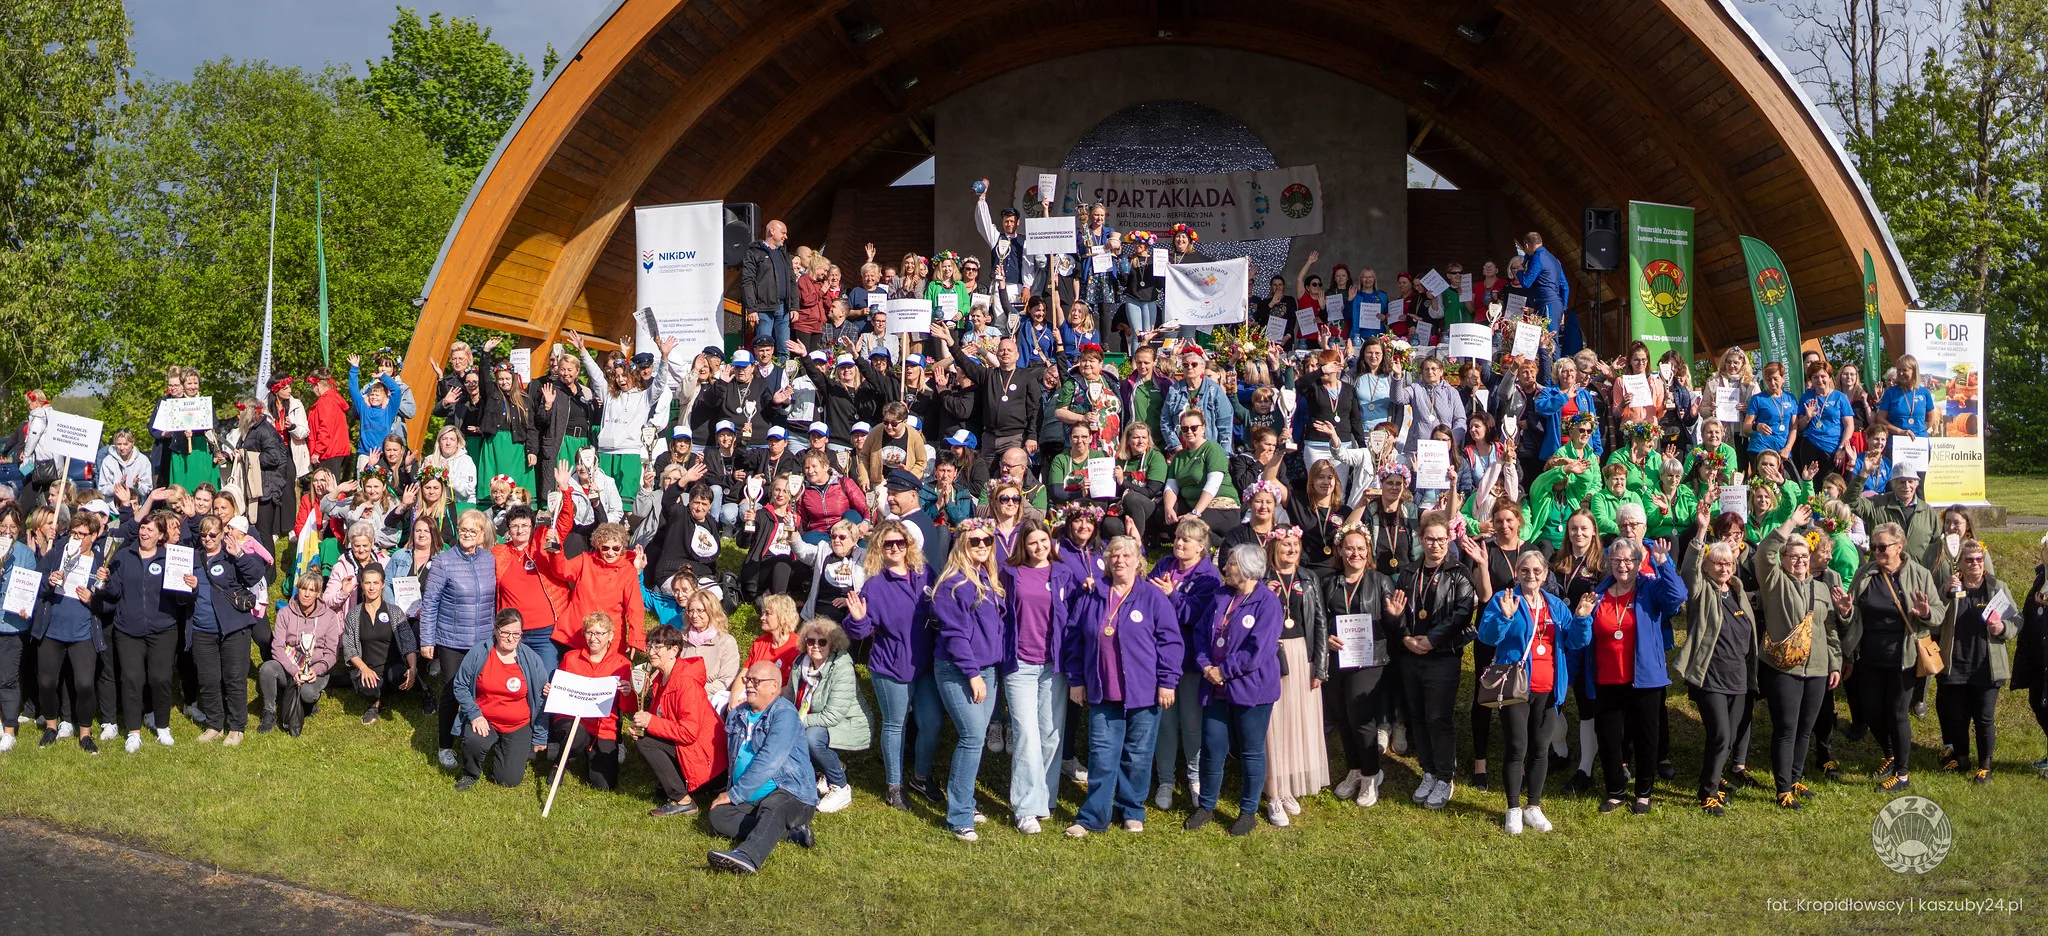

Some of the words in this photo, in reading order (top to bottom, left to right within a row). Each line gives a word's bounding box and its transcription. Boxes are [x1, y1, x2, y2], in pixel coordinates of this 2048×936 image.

[1152, 178, 1188, 186] POMORSKA
[1284, 185, 1307, 198] LZS
[1094, 188, 1236, 208] SPARTAKIADA
[1119, 220, 1132, 228] KÓŁ
[1637, 225, 1662, 234] Pomorskie
[658, 250, 696, 260] NIKiDW
[1202, 266, 1228, 276] Łubiana
[1646, 262, 1680, 278] LZS
[1186, 306, 1226, 320] Porcelanki
[1925, 322, 1968, 341] PODR
[1641, 334, 1688, 342] www.lzs-pomorski.pl
[16, 578, 33, 586] DYPLOM
